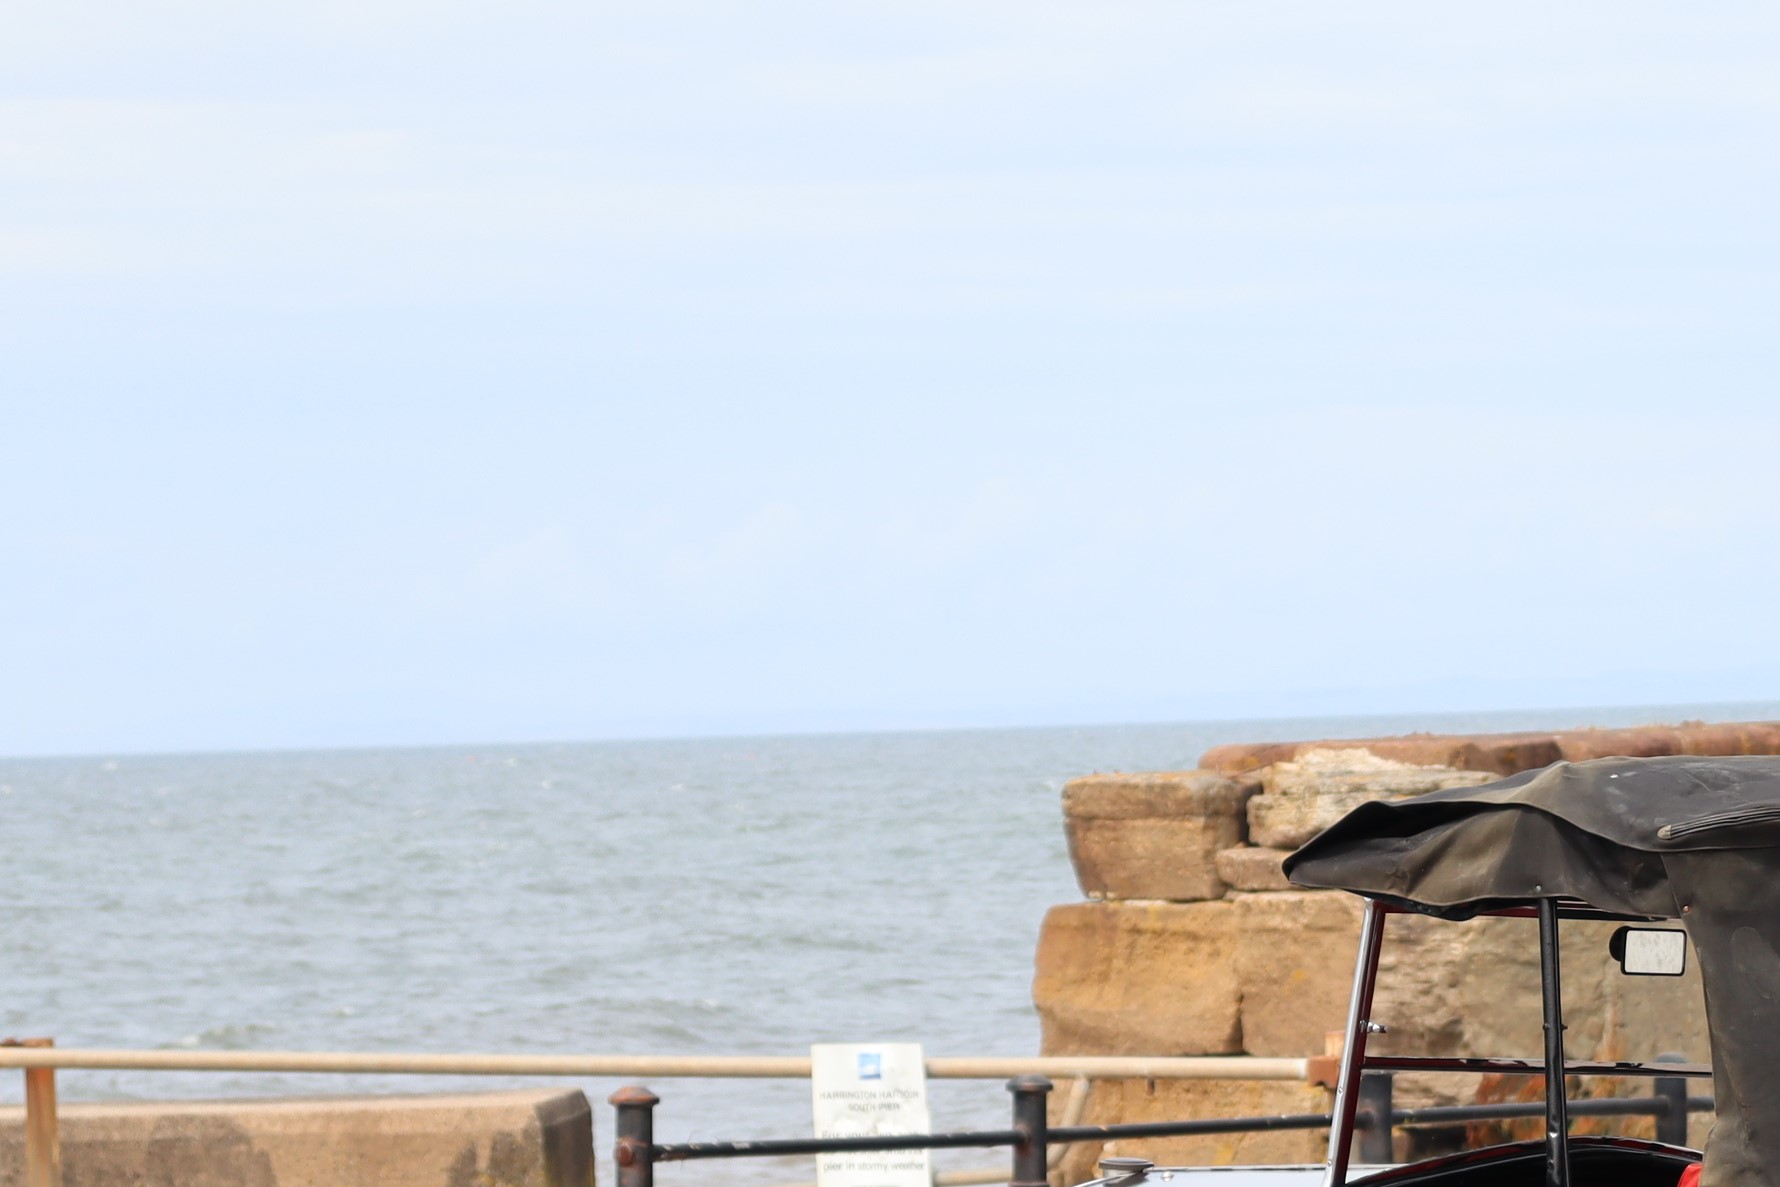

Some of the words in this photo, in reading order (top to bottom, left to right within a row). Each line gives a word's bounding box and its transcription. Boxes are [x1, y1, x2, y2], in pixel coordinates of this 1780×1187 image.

[819, 1090, 876, 1099] HARRINGTON
[848, 1103, 875, 1112] SOUTH
[823, 1162, 841, 1174] pier
